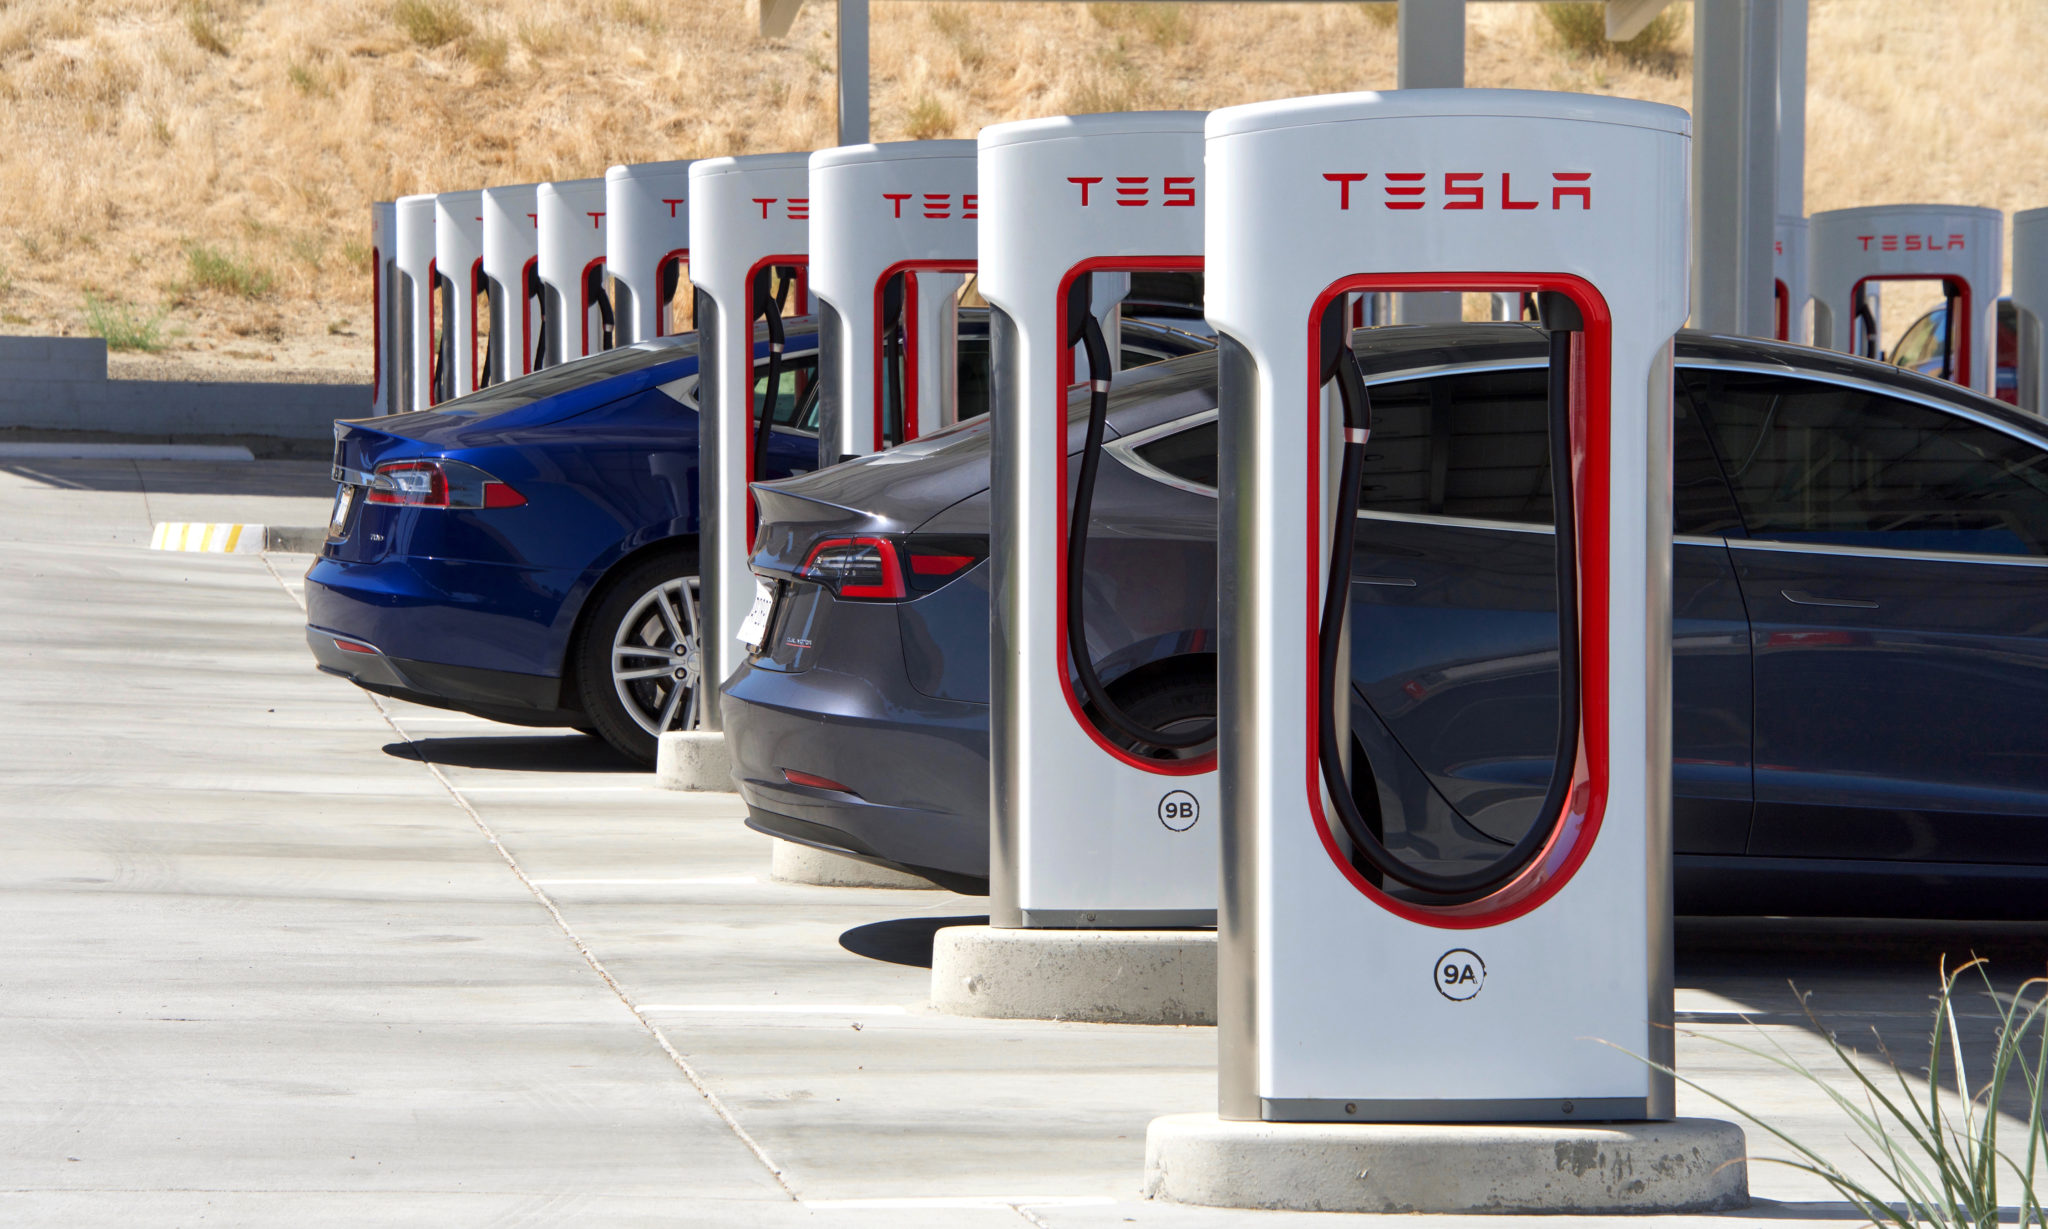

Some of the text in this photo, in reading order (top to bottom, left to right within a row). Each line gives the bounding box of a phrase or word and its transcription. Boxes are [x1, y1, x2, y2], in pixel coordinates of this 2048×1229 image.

[1322, 172, 1592, 210] TESLA
[1857, 234, 1965, 251] TESLA
[1165, 802, 1193, 818] 9B
[1443, 964, 1478, 984] 9A
